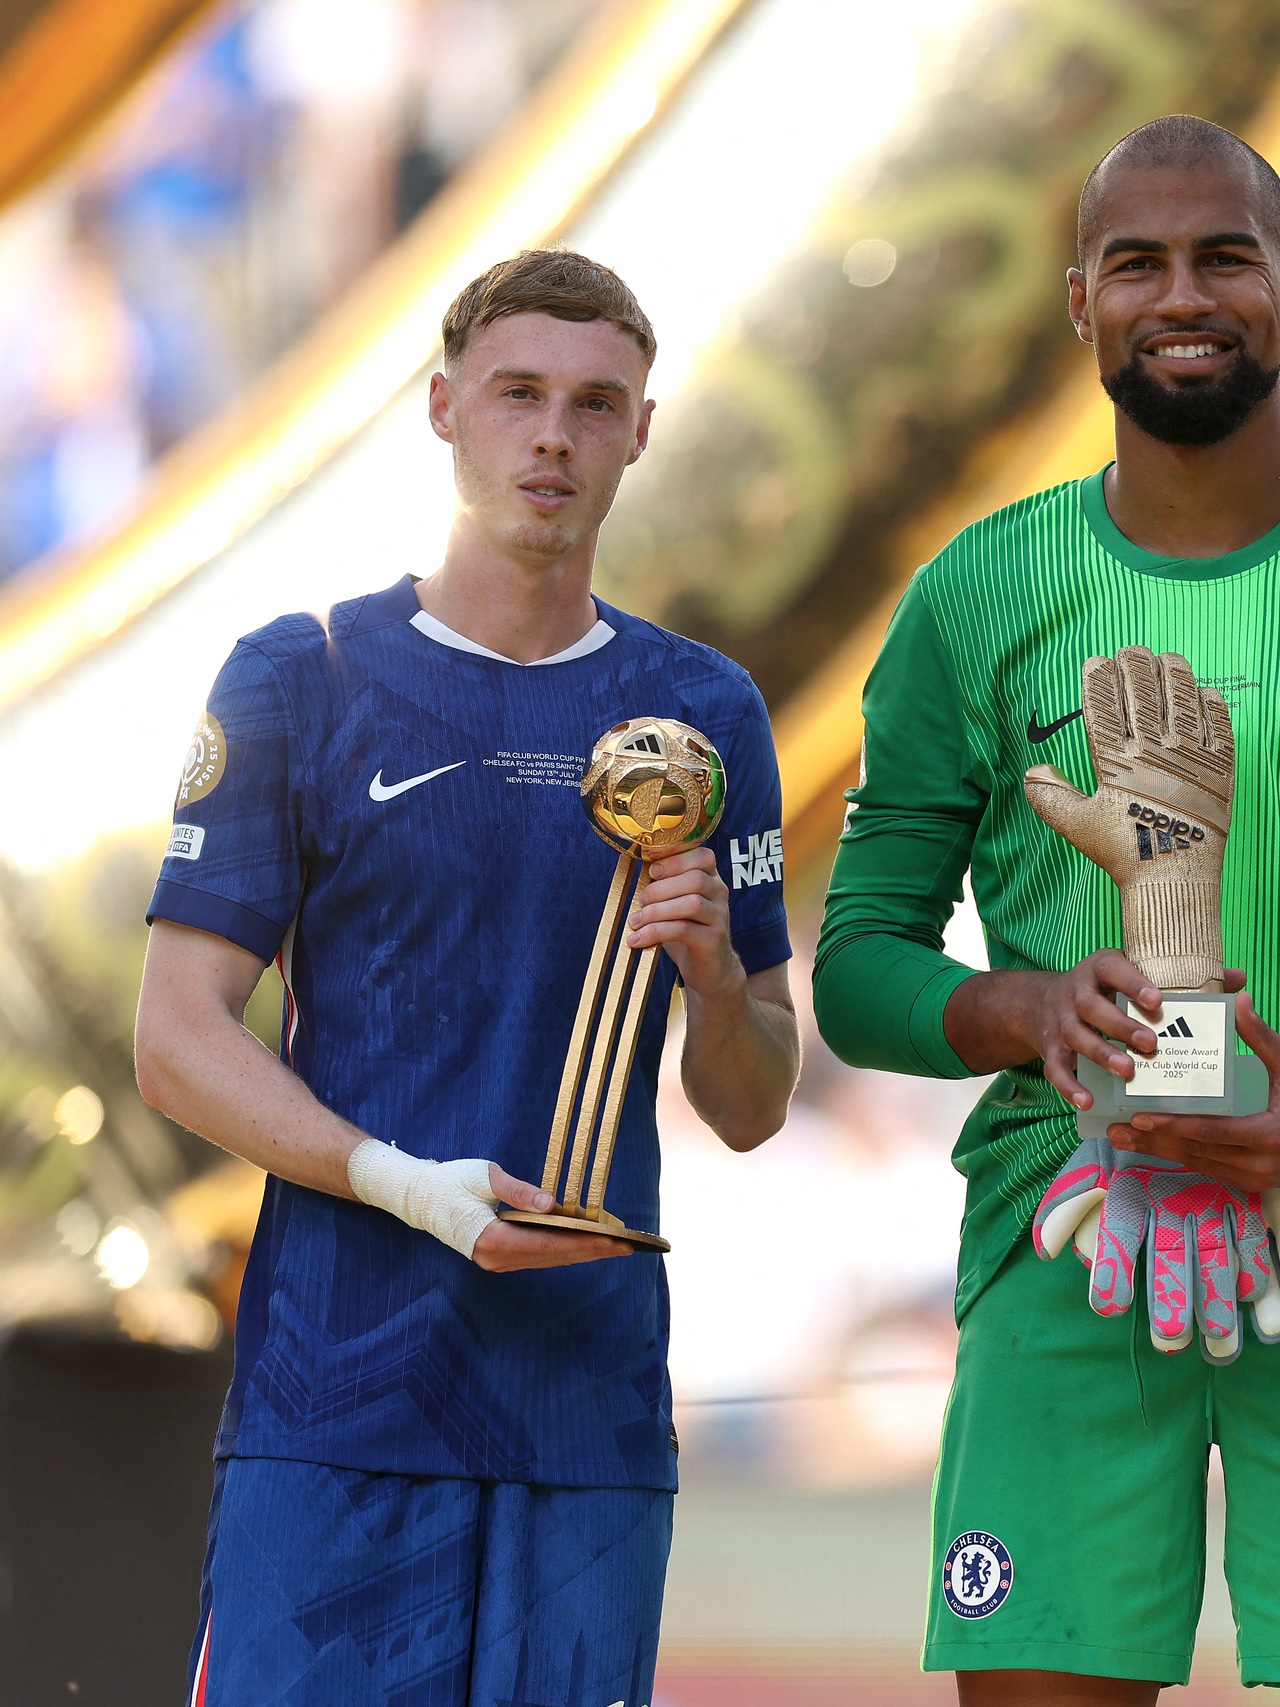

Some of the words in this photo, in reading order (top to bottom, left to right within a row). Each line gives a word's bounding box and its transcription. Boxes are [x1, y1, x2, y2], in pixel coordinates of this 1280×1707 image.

[1195, 677, 1212, 685] ORLD
[1230, 674, 1246, 683] FINAL
[209, 745, 218, 760] 25
[512, 752, 532, 760] CLUB
[532, 753, 558, 761] WORLD
[560, 754, 574, 762] CUP
[483, 759, 515, 767] CHELSEA
[556, 763, 583, 772] SAINT-G
[194, 765, 216, 787] USA
[523, 777, 545, 785] YORK,
[559, 771, 575, 779] JULY
[1128, 802, 1205, 842] adidas
[730, 828, 783, 863] LIVE
[732, 854, 784, 889] NAT
[1165, 1048, 1189, 1056] Glove
[1191, 1048, 1218, 1056] Award
[1152, 1061, 1171, 1069] Club
[1173, 1061, 1199, 1069] World
[1201, 1062, 1218, 1071] Cup
[953, 1533, 999, 1553] CHELSEA
[950, 1599, 979, 1615] FOOTBALL
[982, 1598, 998, 1612] CLUB
